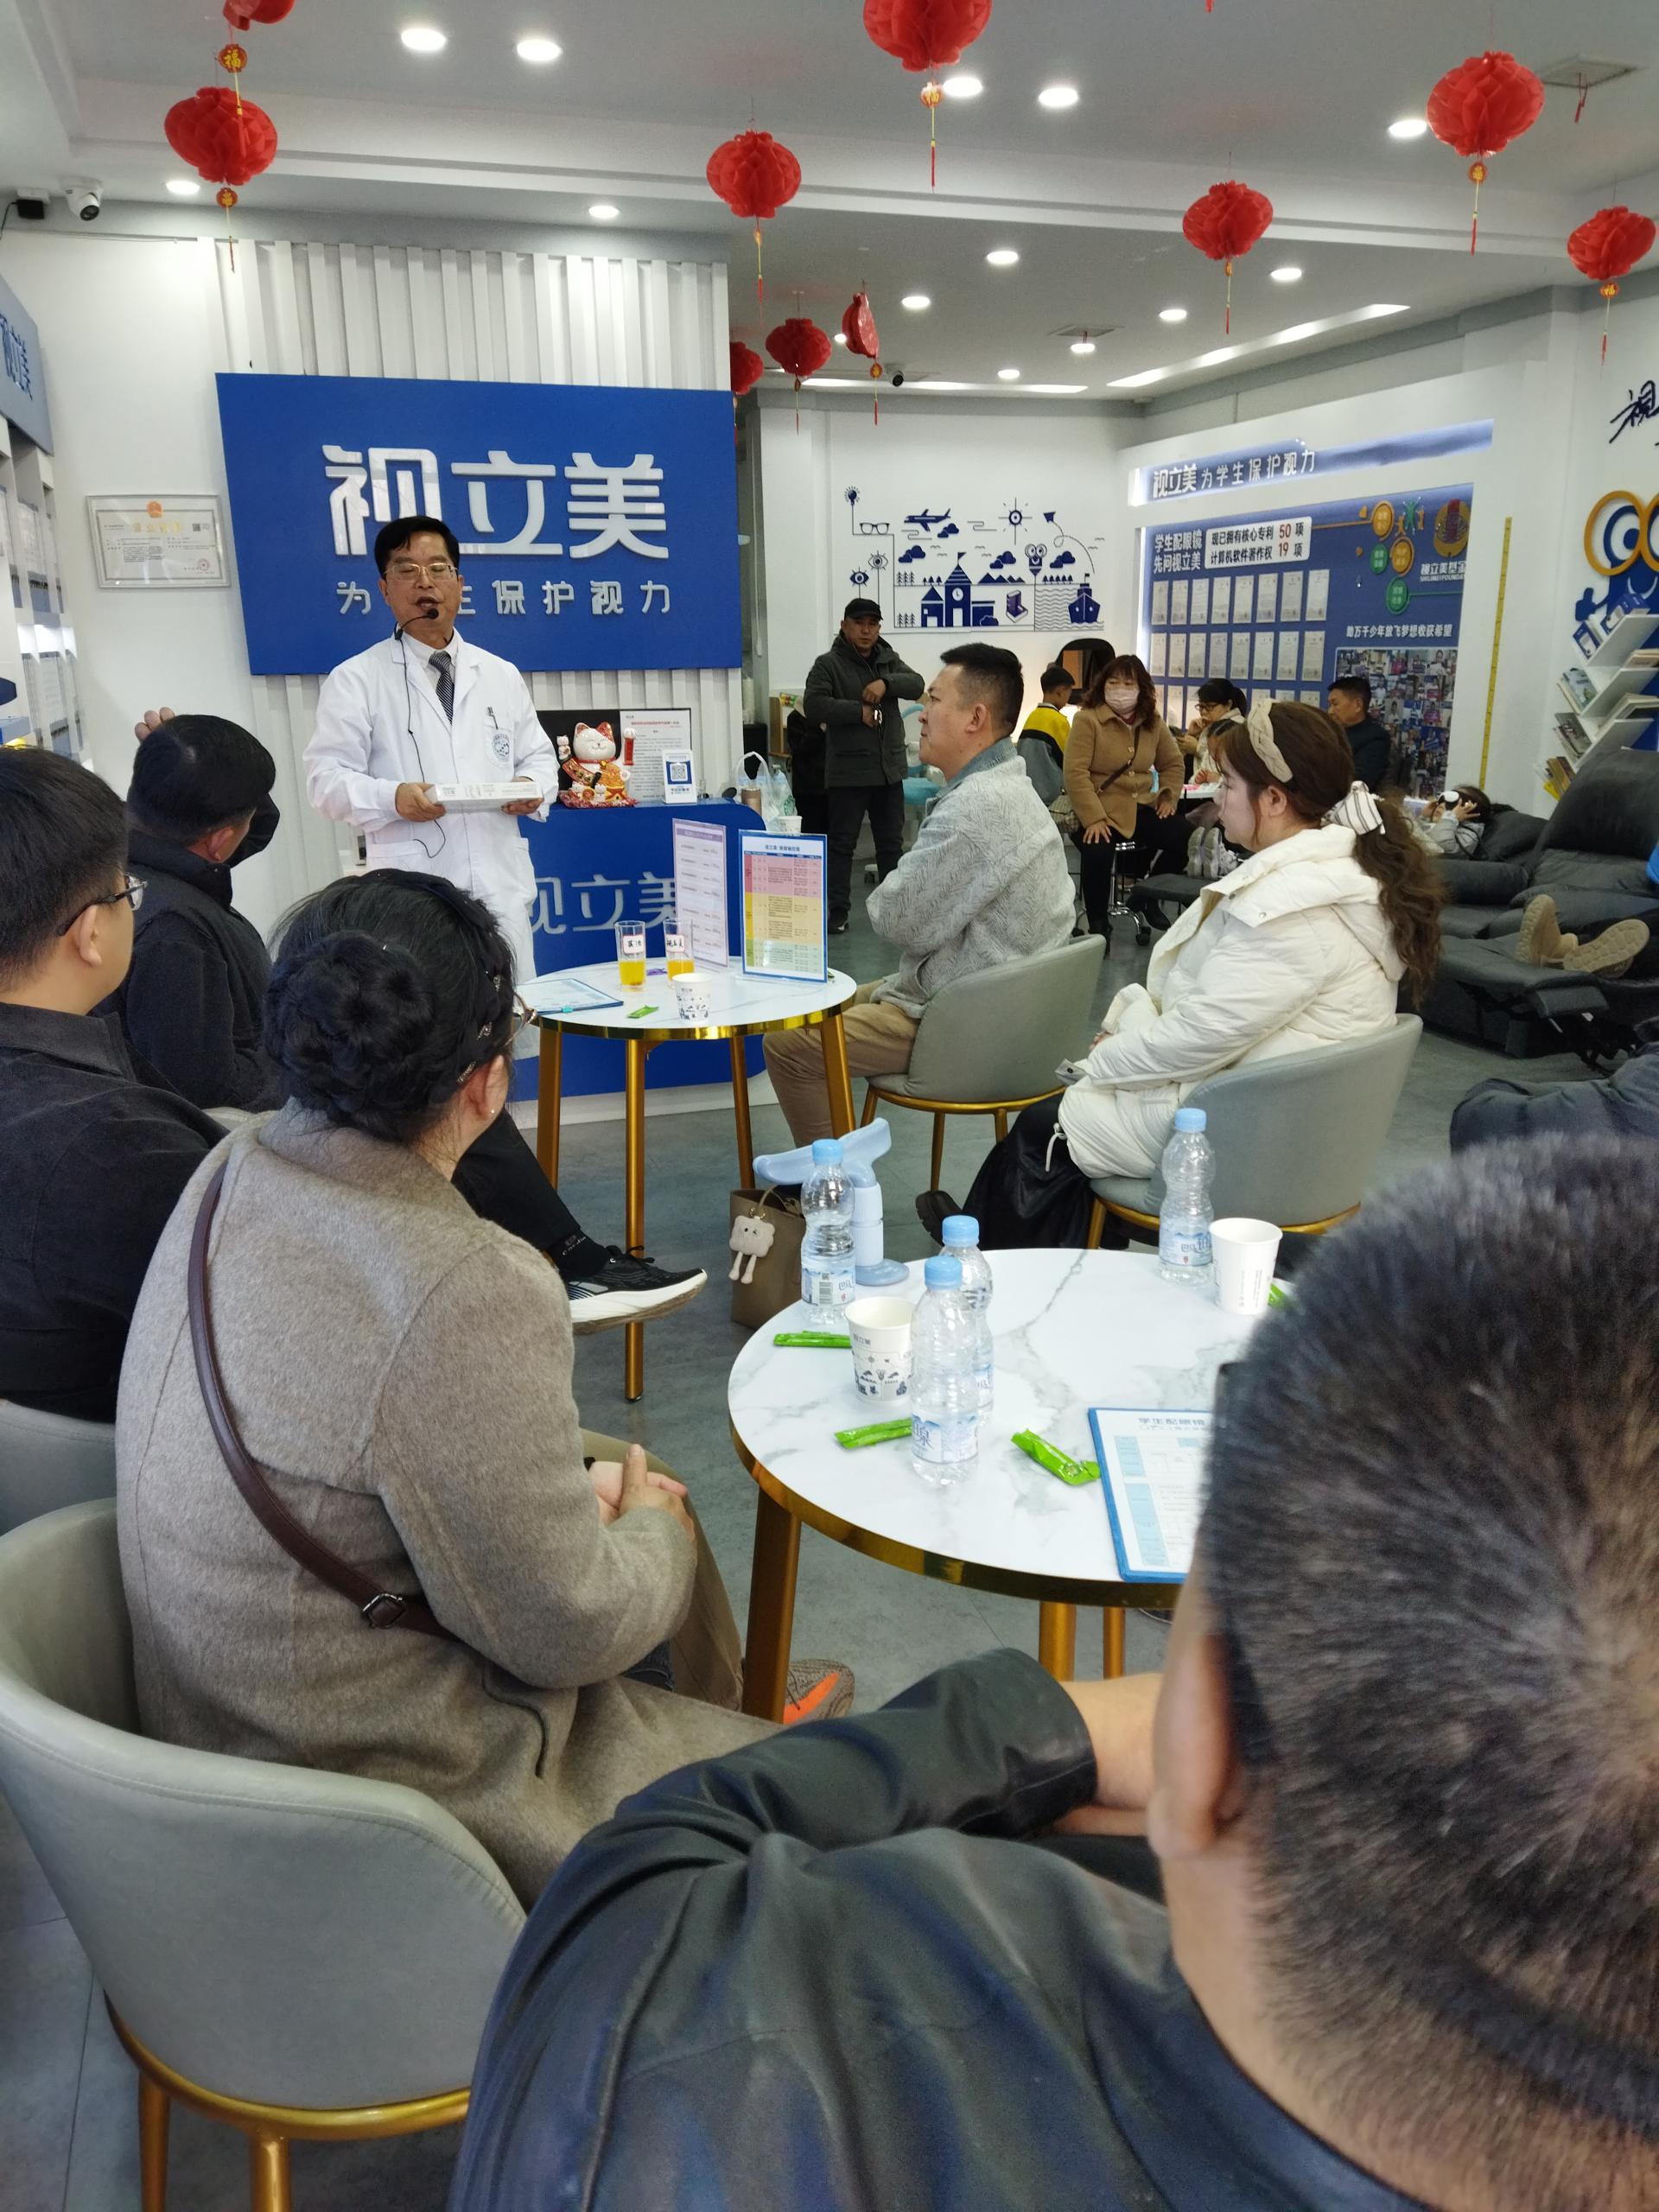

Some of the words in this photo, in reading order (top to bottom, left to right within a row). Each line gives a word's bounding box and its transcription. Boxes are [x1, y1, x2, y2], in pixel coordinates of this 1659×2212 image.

[1153, 462, 1198, 499] 视立美
[1201, 448, 1315, 490] 为学生保护视力
[321, 444, 670, 559] 视立美
[1154, 529, 1203, 554] 学生配眼镜
[1211, 525, 1274, 546] 现已拥有核心专利
[1279, 523, 1292, 539] 50
[1295, 521, 1305, 537] 项
[1154, 550, 1201, 575] 先问视立美
[1210, 546, 1273, 565] 计算机软件著作权
[1278, 542, 1289, 557] 19
[1294, 542, 1304, 558] 项
[336, 580, 671, 615] 为生保护视力
